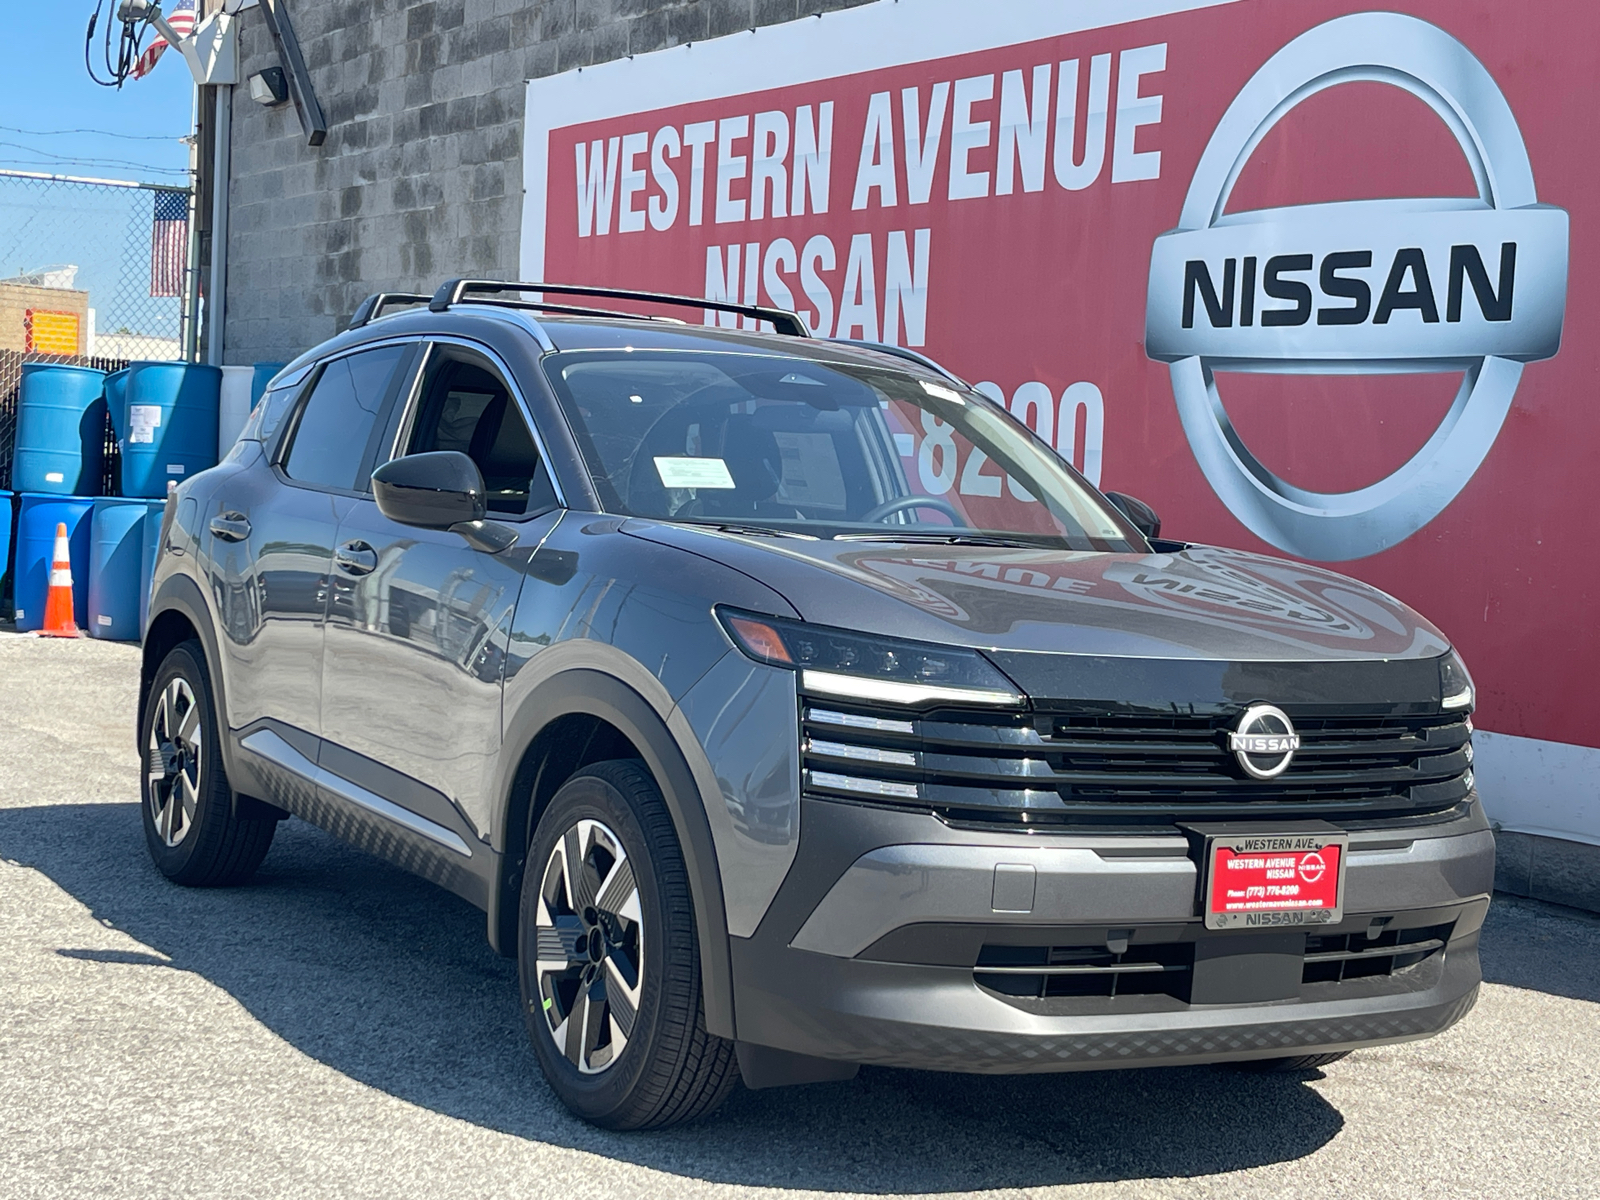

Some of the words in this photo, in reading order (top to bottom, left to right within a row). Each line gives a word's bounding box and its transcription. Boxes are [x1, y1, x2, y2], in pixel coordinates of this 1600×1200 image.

[575, 101, 834, 237] WESTERN
[851, 43, 1167, 211] AVENUE
[704, 228, 931, 347] NISSAN
[1182, 242, 1517, 328] NISSAN
[1233, 738, 1299, 750] NISSAN
[1244, 839, 1292, 850] WESTERN
[1227, 858, 1265, 870] WESTERN
[1265, 857, 1296, 868] AVENUE
[1266, 869, 1295, 879] NISSAN
[1246, 886, 1265, 899] (773)
[1266, 885, 1299, 896] 776-8200
[1246, 912, 1303, 925] NISSAN
